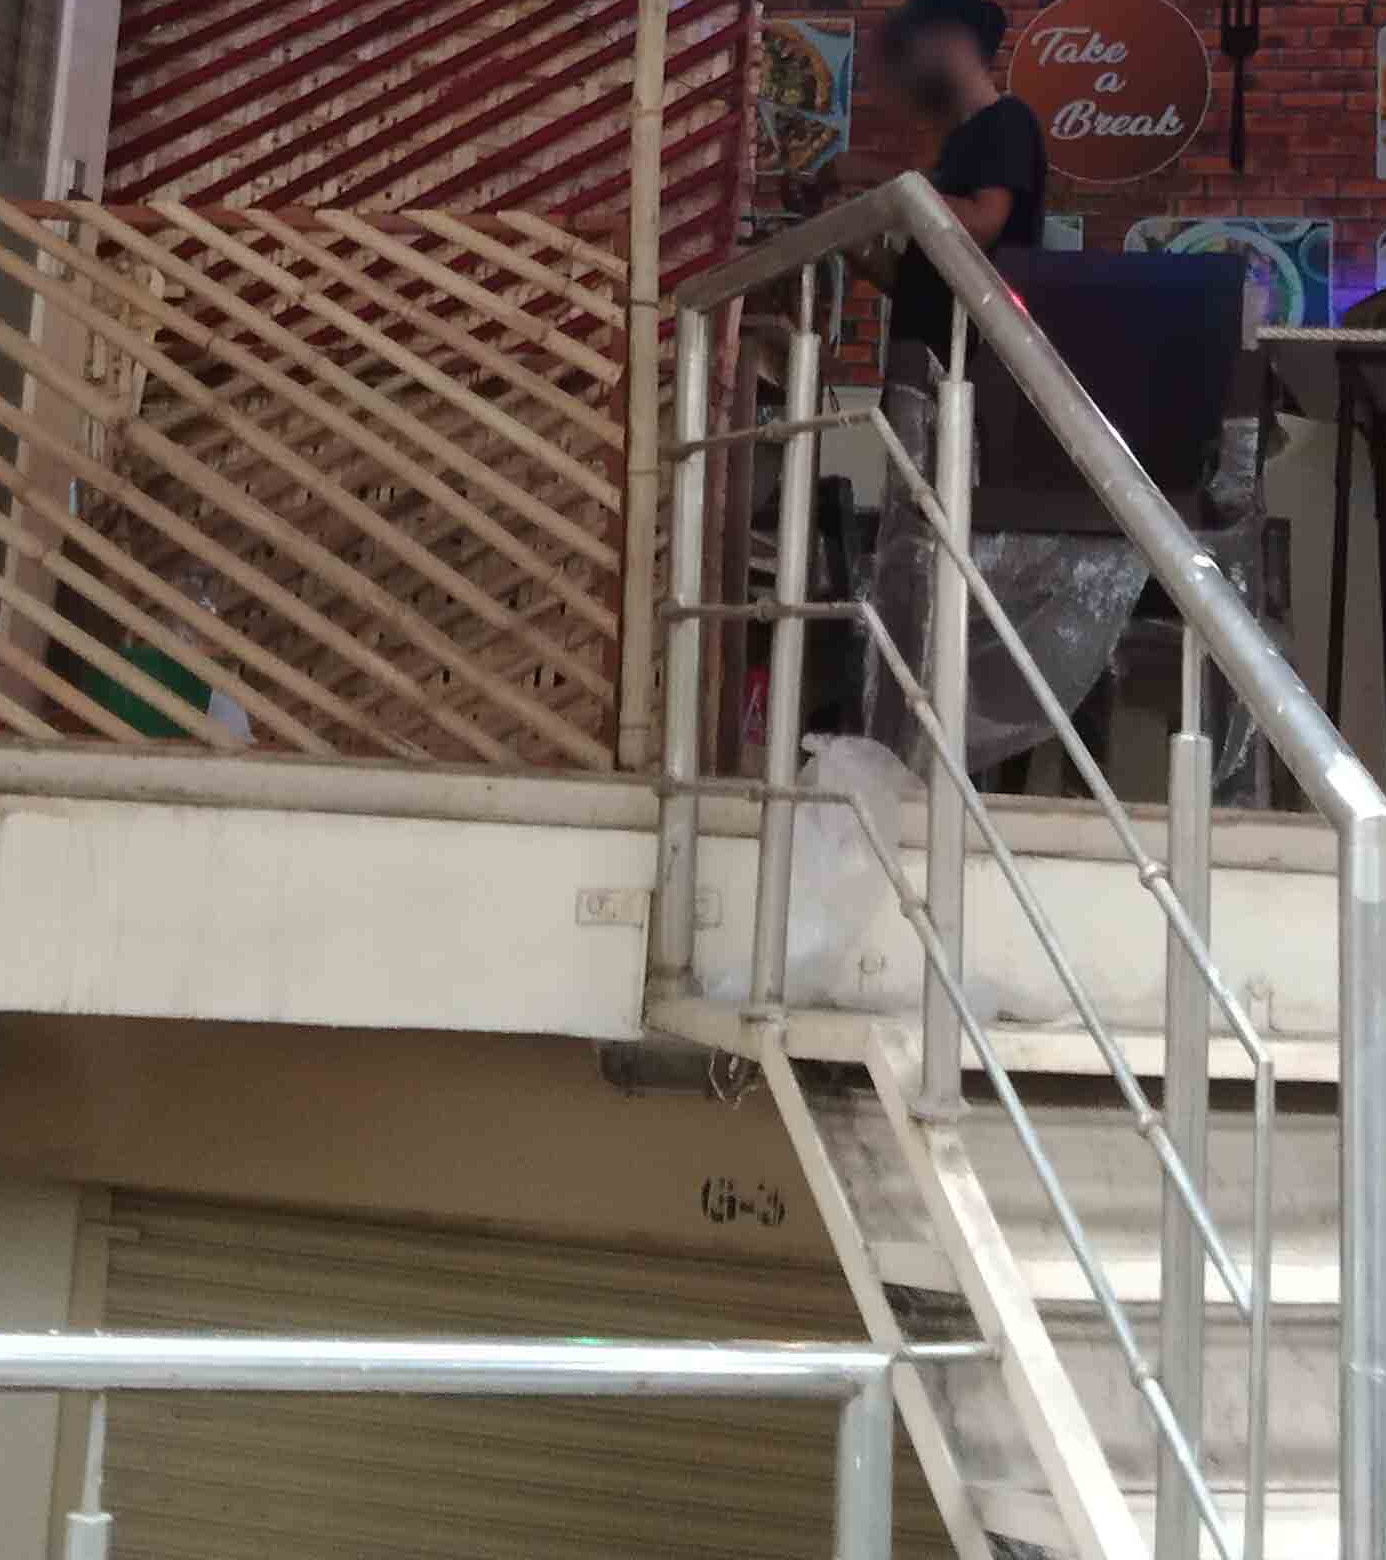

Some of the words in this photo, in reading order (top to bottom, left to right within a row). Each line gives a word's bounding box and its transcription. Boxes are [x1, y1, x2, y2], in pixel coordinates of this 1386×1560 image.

[1031, 26, 1128, 65] Take
[1095, 71, 1125, 93] a
[1050, 100, 1184, 142] Break
